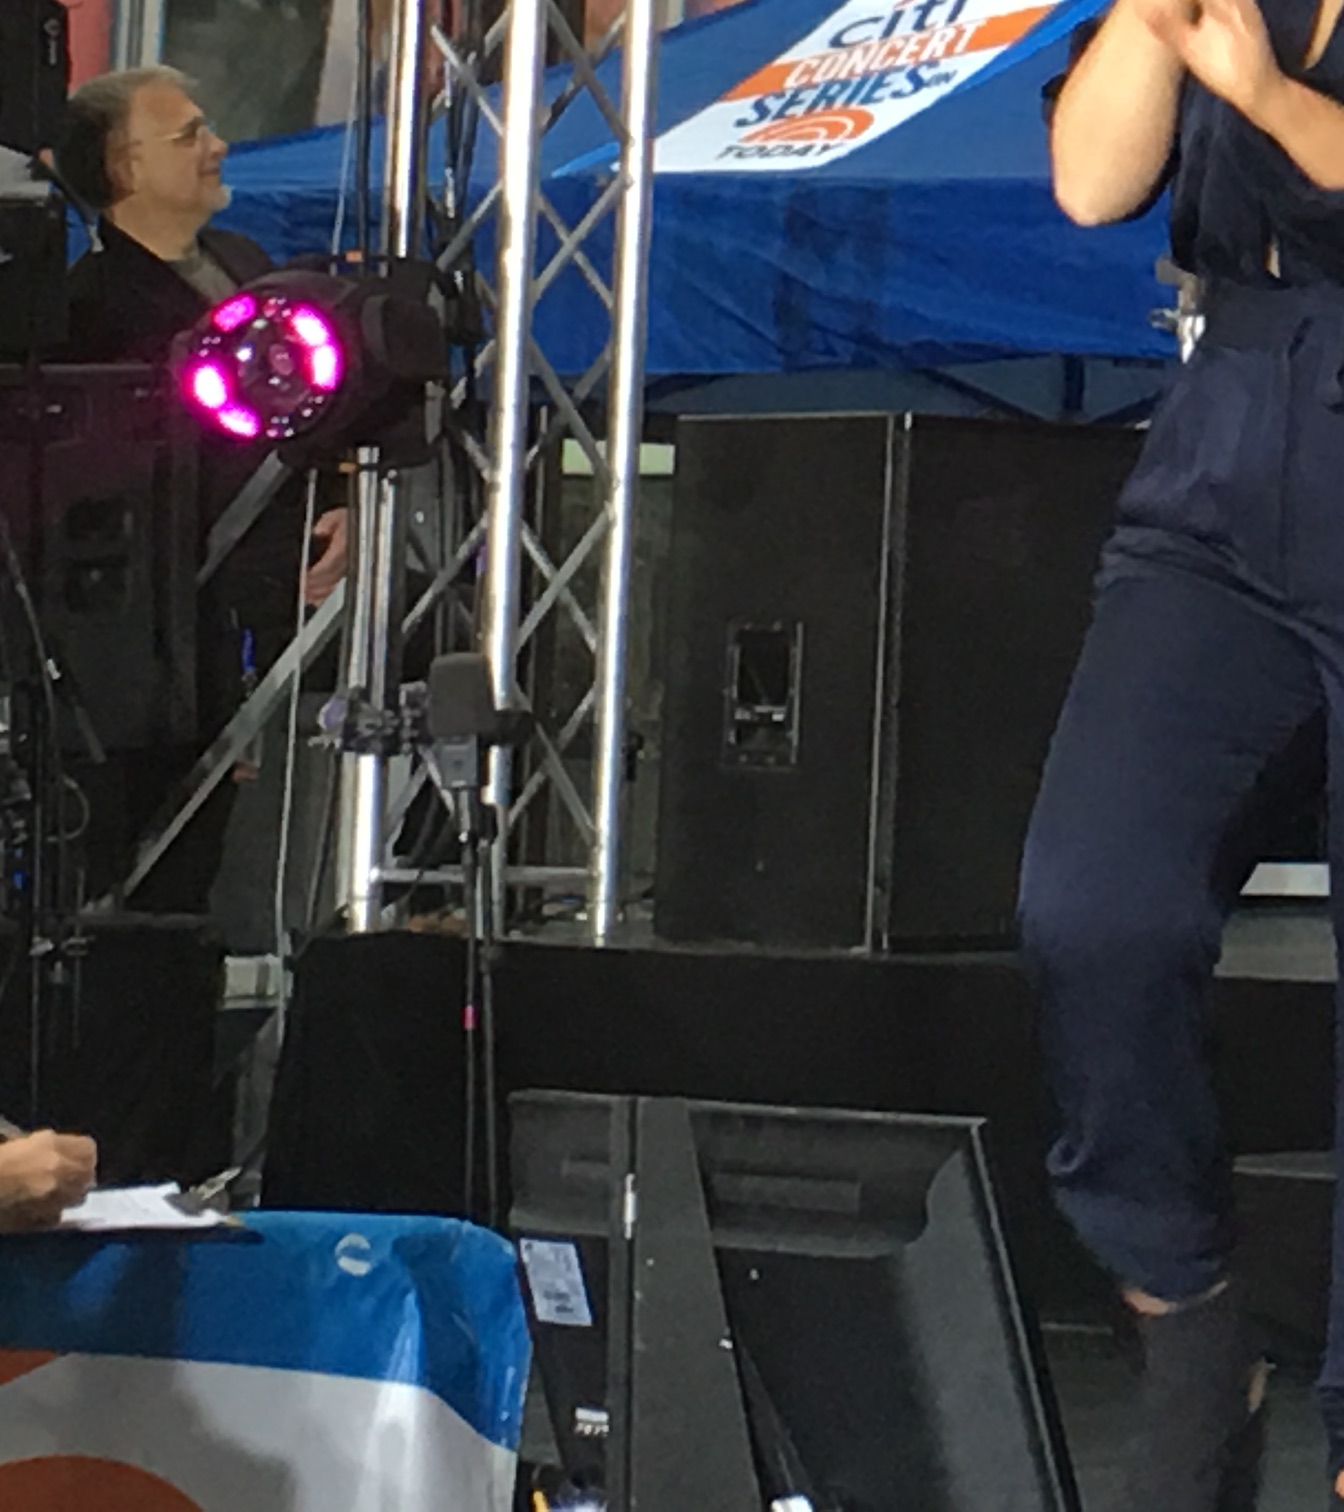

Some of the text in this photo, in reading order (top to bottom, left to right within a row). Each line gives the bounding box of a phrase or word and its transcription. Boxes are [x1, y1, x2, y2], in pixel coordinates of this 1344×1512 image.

[783, 19, 987, 89] CONCERT
[733, 61, 941, 128] SERIES
[715, 141, 843, 161] TODAY
